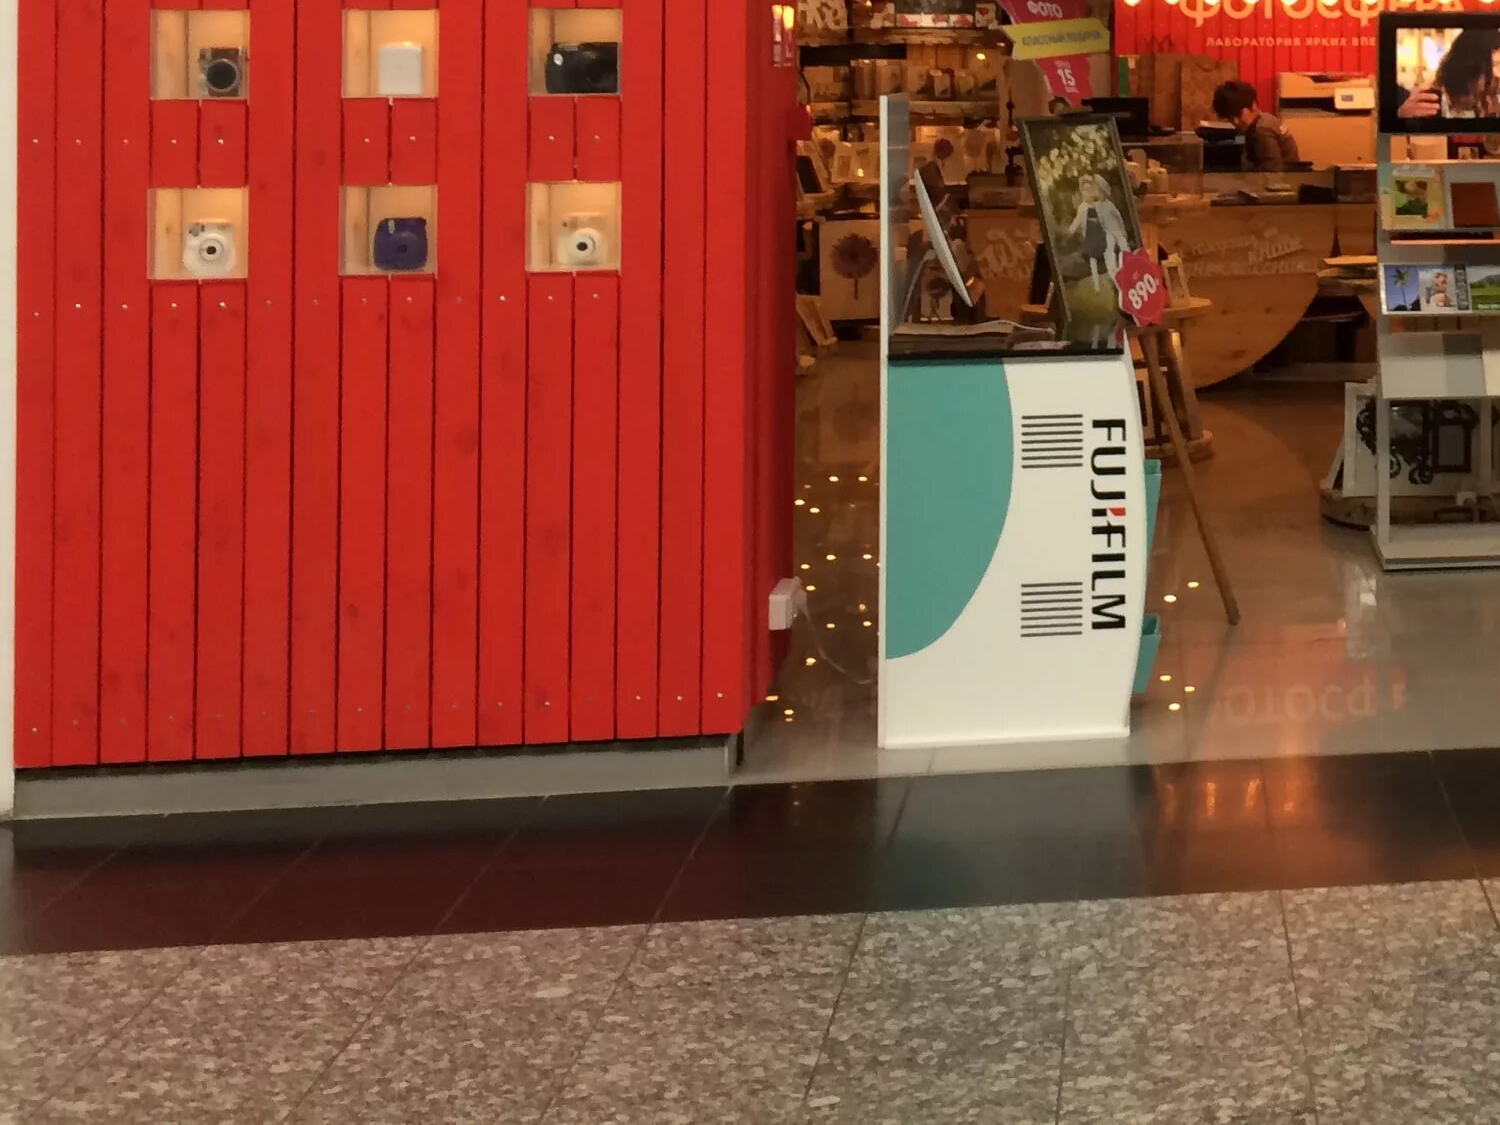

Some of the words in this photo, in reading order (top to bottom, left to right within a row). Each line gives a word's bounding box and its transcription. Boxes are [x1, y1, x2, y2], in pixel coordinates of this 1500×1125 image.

[1027, 0, 1063, 19] ФОТО
[1205, 35, 1301, 48] ЛАБОРАТОРИЯ
[1090, 418, 1127, 630] FUJIFILM
